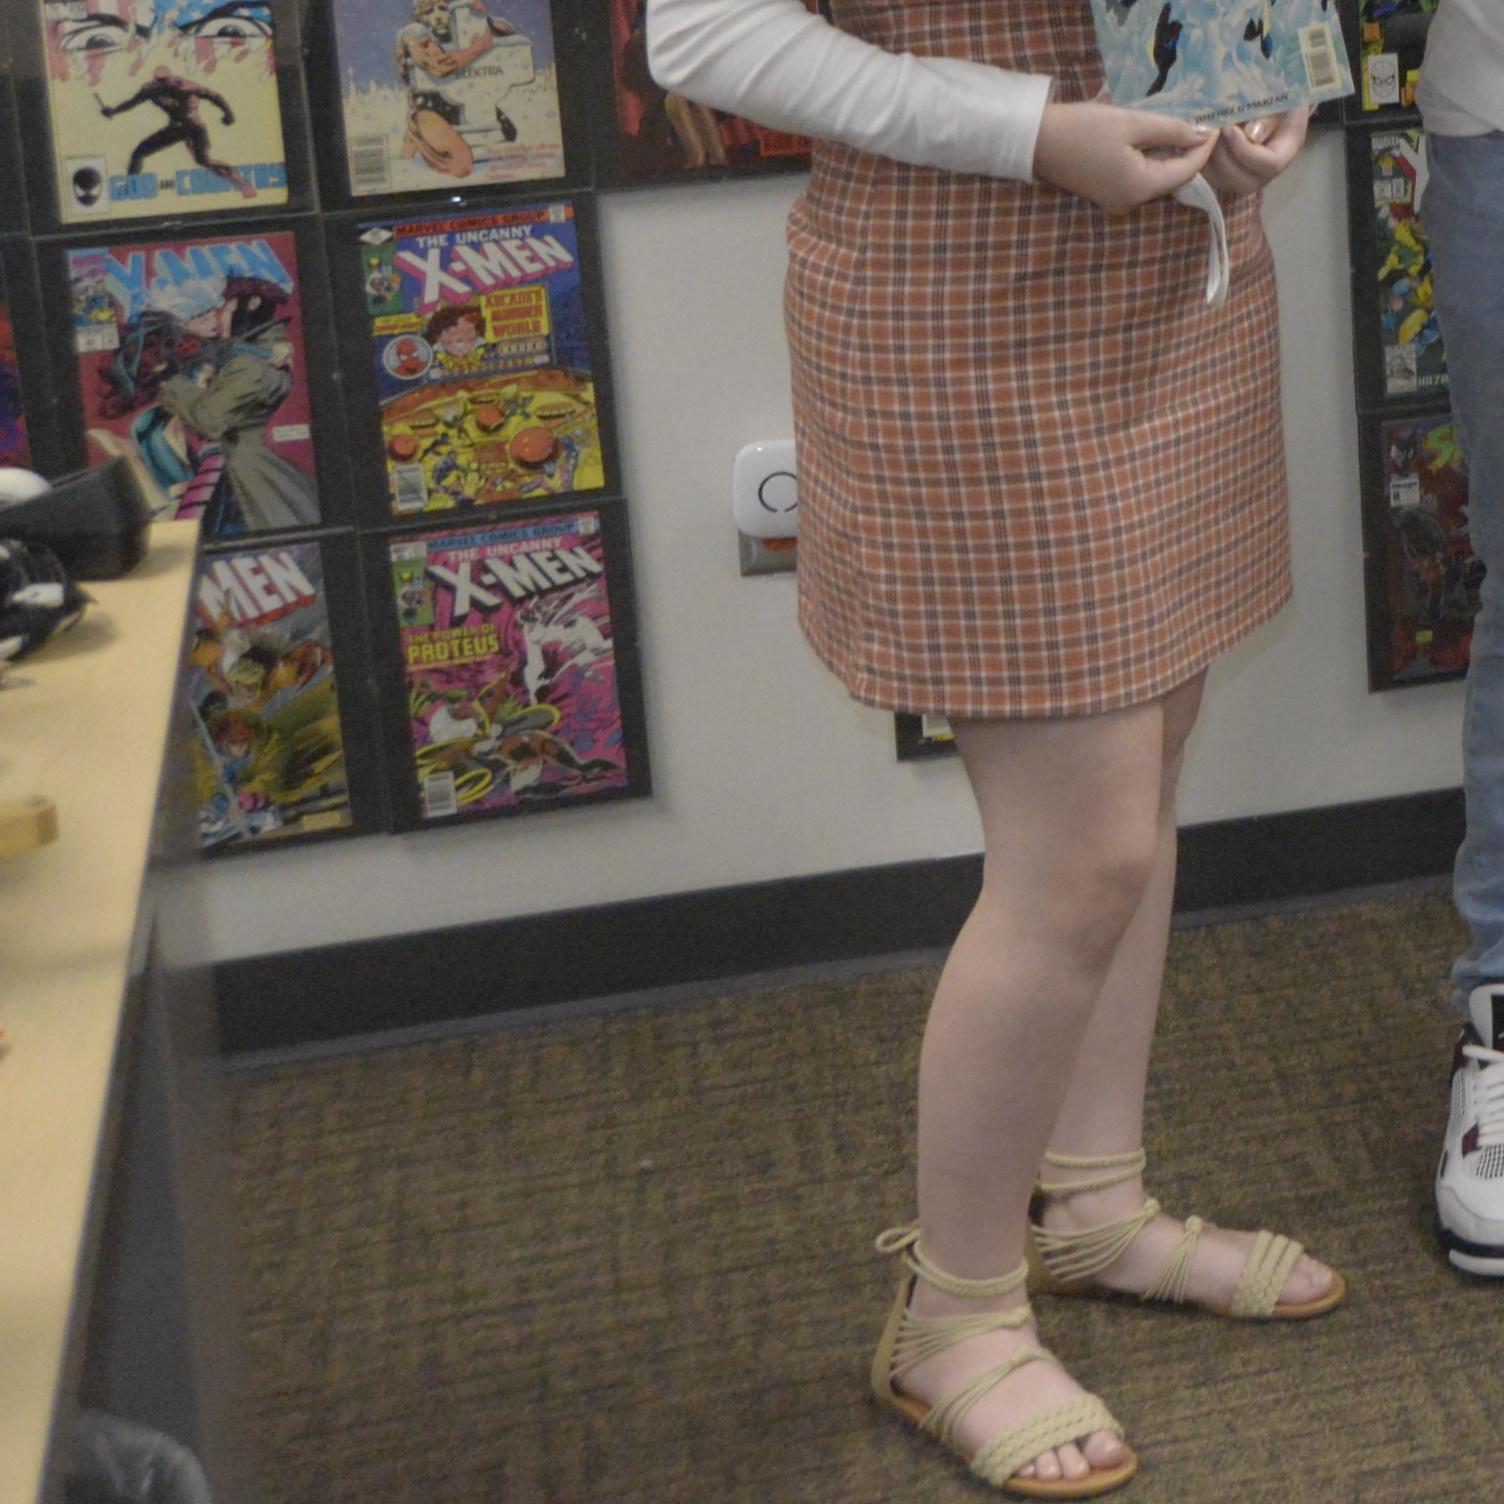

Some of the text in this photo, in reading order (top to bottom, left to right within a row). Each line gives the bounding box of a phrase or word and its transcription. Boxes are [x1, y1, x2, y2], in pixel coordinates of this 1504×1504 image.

[455, 65, 504, 79] ELEKTRA
[109, 162, 288, 200] GOD COUNTRY
[396, 211, 545, 237] MARVEL COMICS GROUP
[415, 224, 534, 249] THE UNCANNY
[394, 234, 574, 315] X-MEN
[427, 522, 576, 553] MARVEL COMICS GROUP
[449, 536, 563, 564] THE UNCANNY
[201, 551, 314, 628] MEN
[430, 546, 604, 617] X-MEN
[406, 634, 501, 663] PROTEUS
